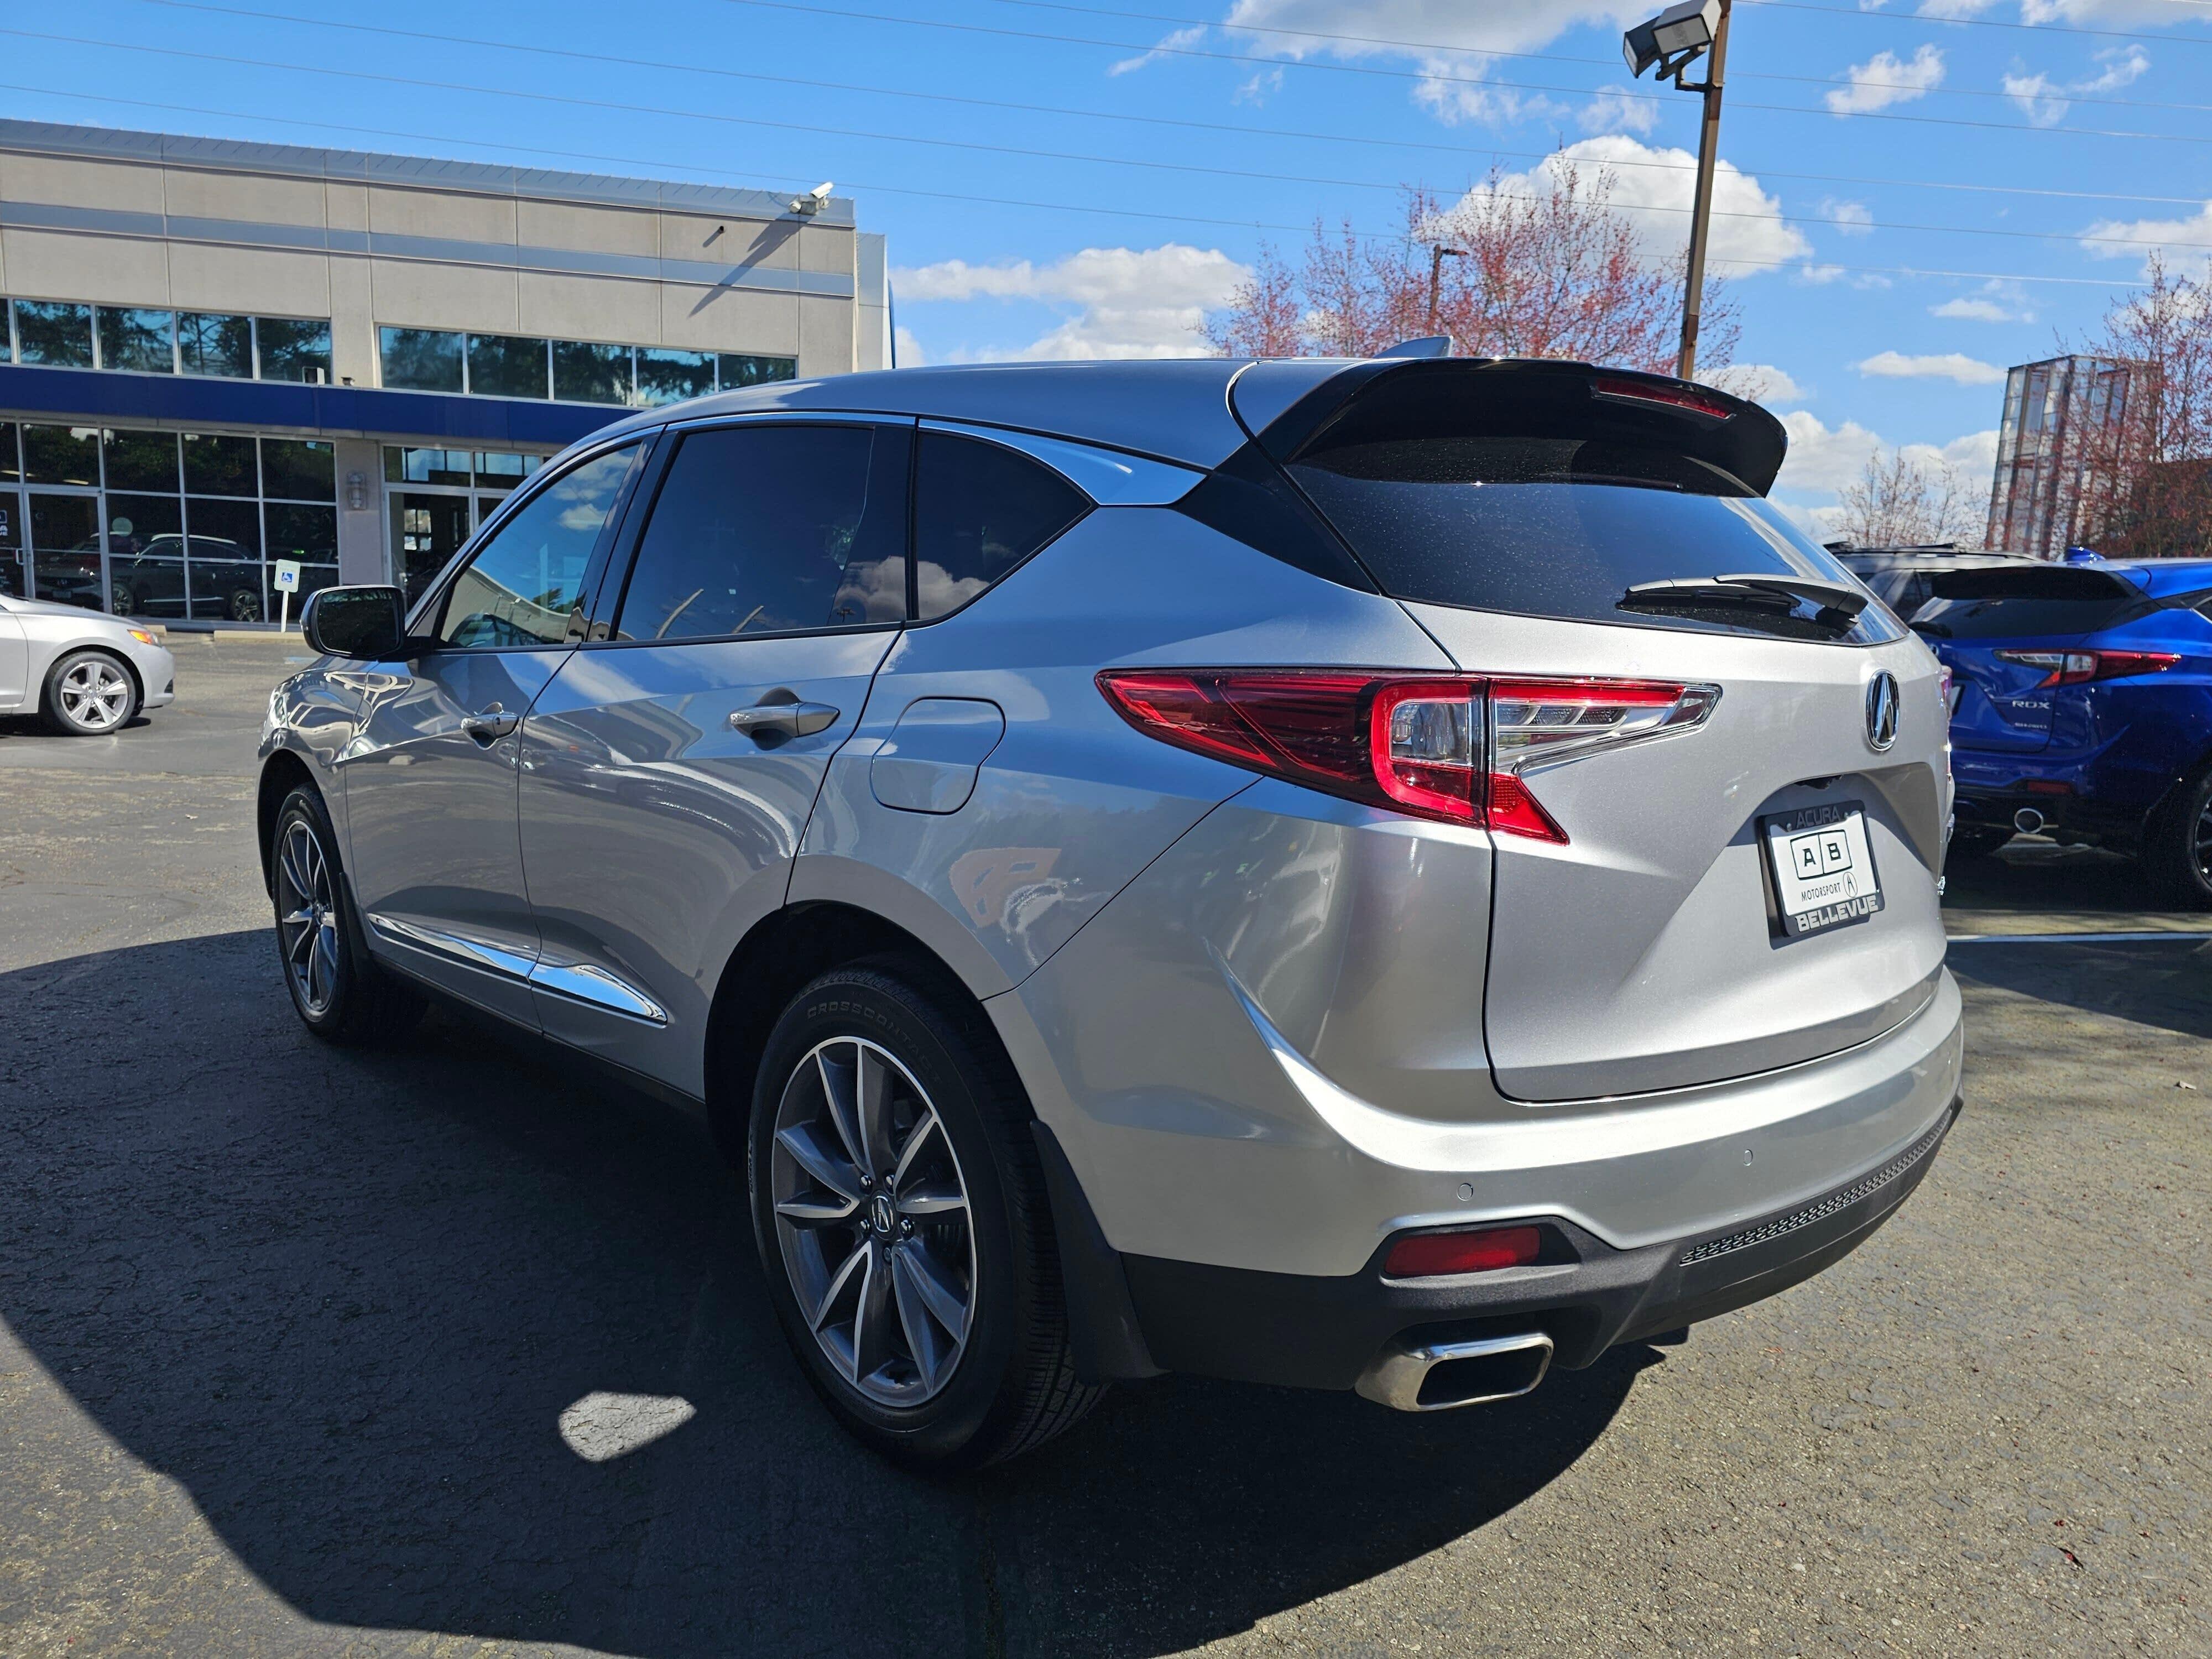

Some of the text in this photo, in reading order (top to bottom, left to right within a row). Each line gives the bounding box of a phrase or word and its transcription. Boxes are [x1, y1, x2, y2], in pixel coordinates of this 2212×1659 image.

[2012, 700, 2050, 709] RDX
[1796, 806, 1841, 829] ACURA
[1802, 842, 1841, 867] A B
[1801, 882, 1841, 902] MOTORSPORT
[1795, 894, 1879, 932] BELLEVUE
